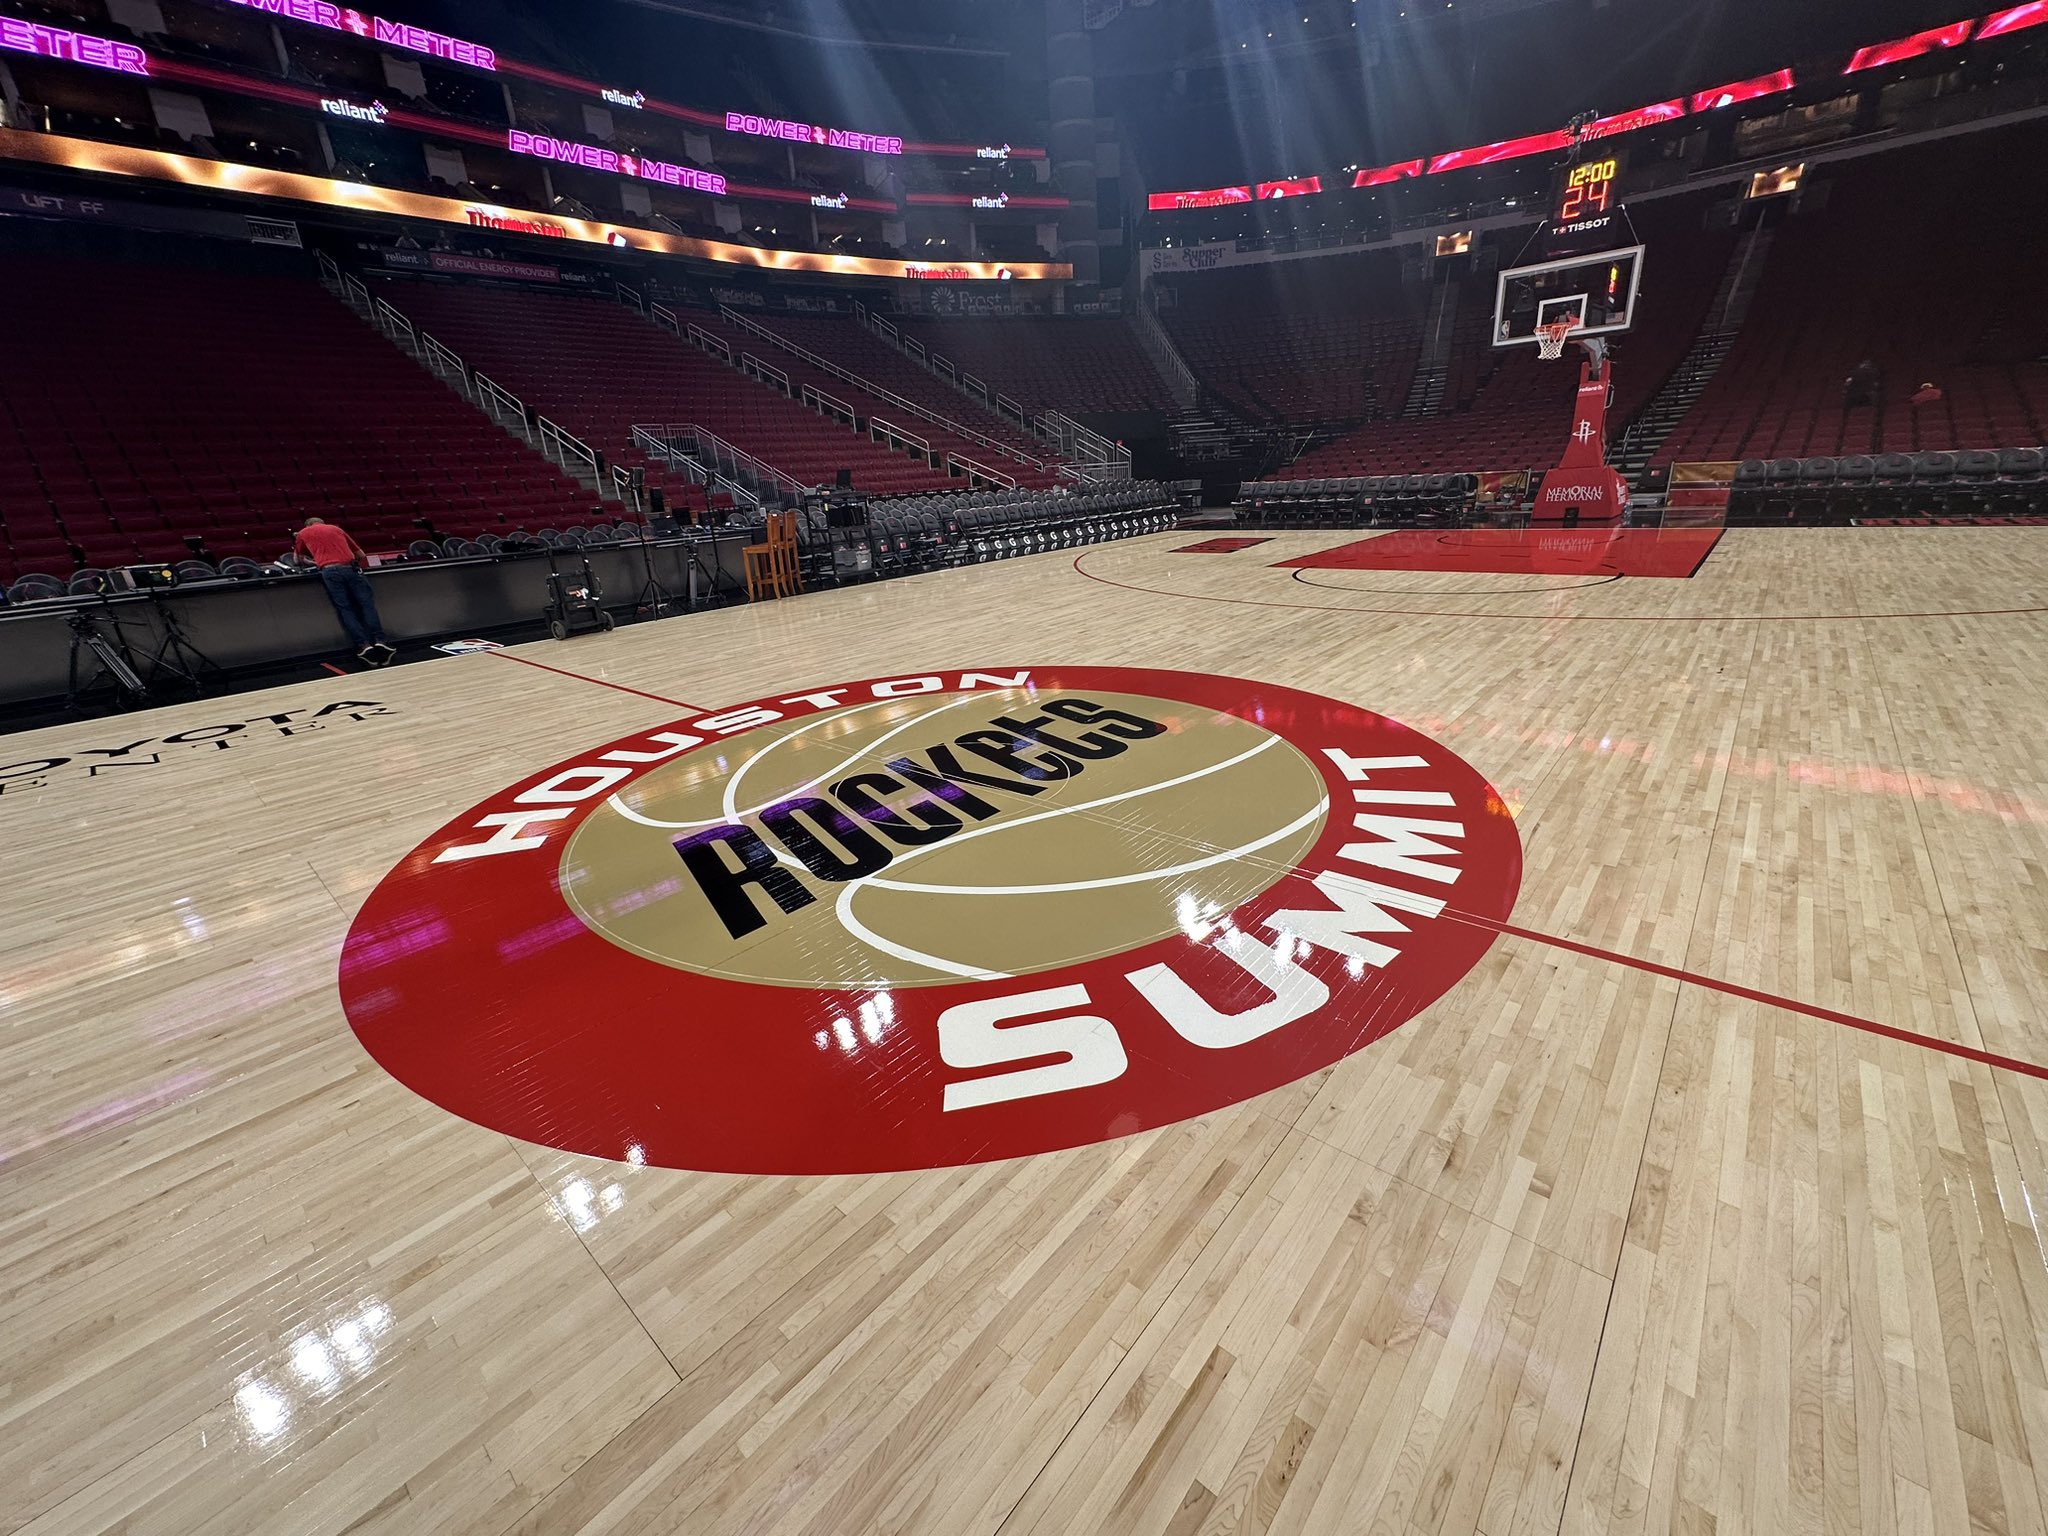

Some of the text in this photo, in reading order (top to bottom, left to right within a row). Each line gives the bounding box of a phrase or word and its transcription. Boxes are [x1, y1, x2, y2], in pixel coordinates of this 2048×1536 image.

[230, 0, 498, 71] WER METER
[726, 111, 903, 155] POWER METER
[508, 128, 728, 196] POWER METER
[1568, 160, 1616, 188] 12:00
[1562, 181, 1609, 219] 24
[1567, 217, 1611, 233] TISSOT
[435, 257, 479, 271] OFFICIAL
[480, 263, 514, 275] ENERGY
[514, 266, 558, 279] PROVIDER
[957, 291, 1002, 311] Frost
[1545, 491, 1604, 502] HERMANN
[1547, 486, 1603, 497] MEMORIAL
[0, 700, 384, 780] OYOTA
[0, 706, 399, 797] ENTER
[430, 669, 1033, 864] HOUSTON
[936, 746, 1468, 1114] SUMMIT
